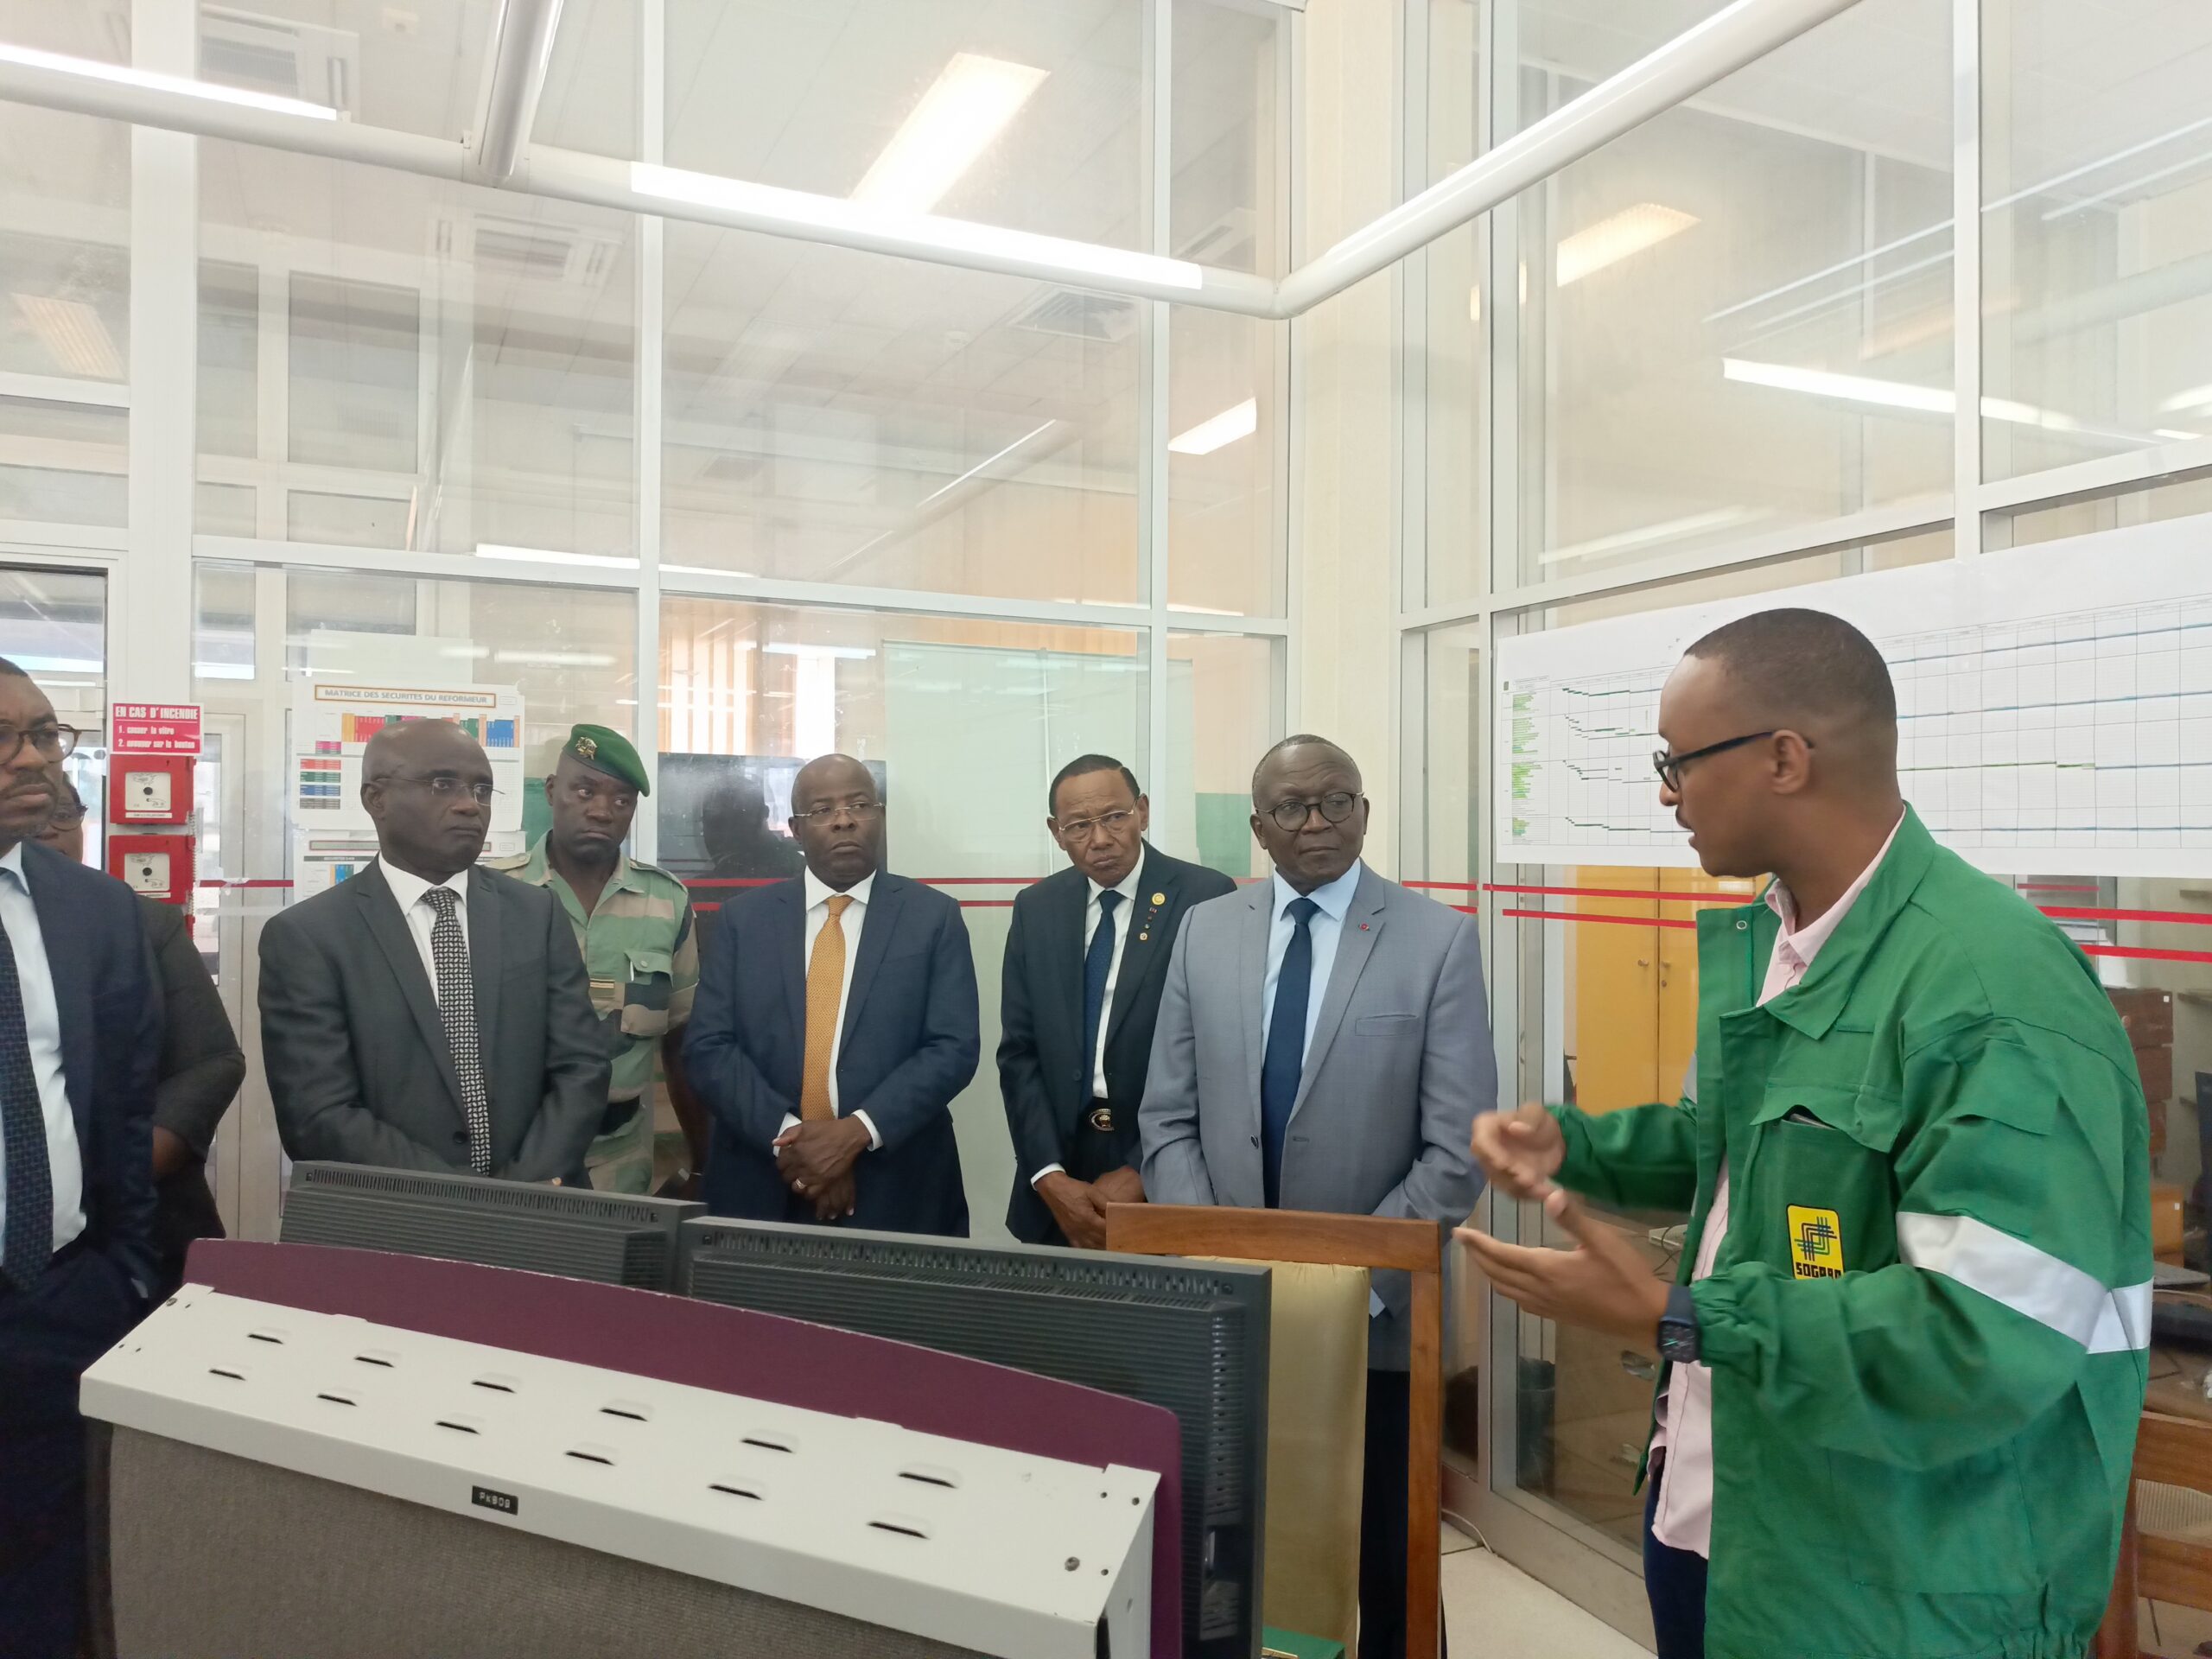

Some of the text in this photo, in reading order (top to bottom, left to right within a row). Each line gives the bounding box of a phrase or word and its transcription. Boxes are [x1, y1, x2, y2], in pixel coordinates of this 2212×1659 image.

[325, 690, 361, 698] MATRICE
[438, 695, 487, 703] REFORMEUR
[115, 706, 127, 717] EN
[129, 707, 147, 718] CAS
